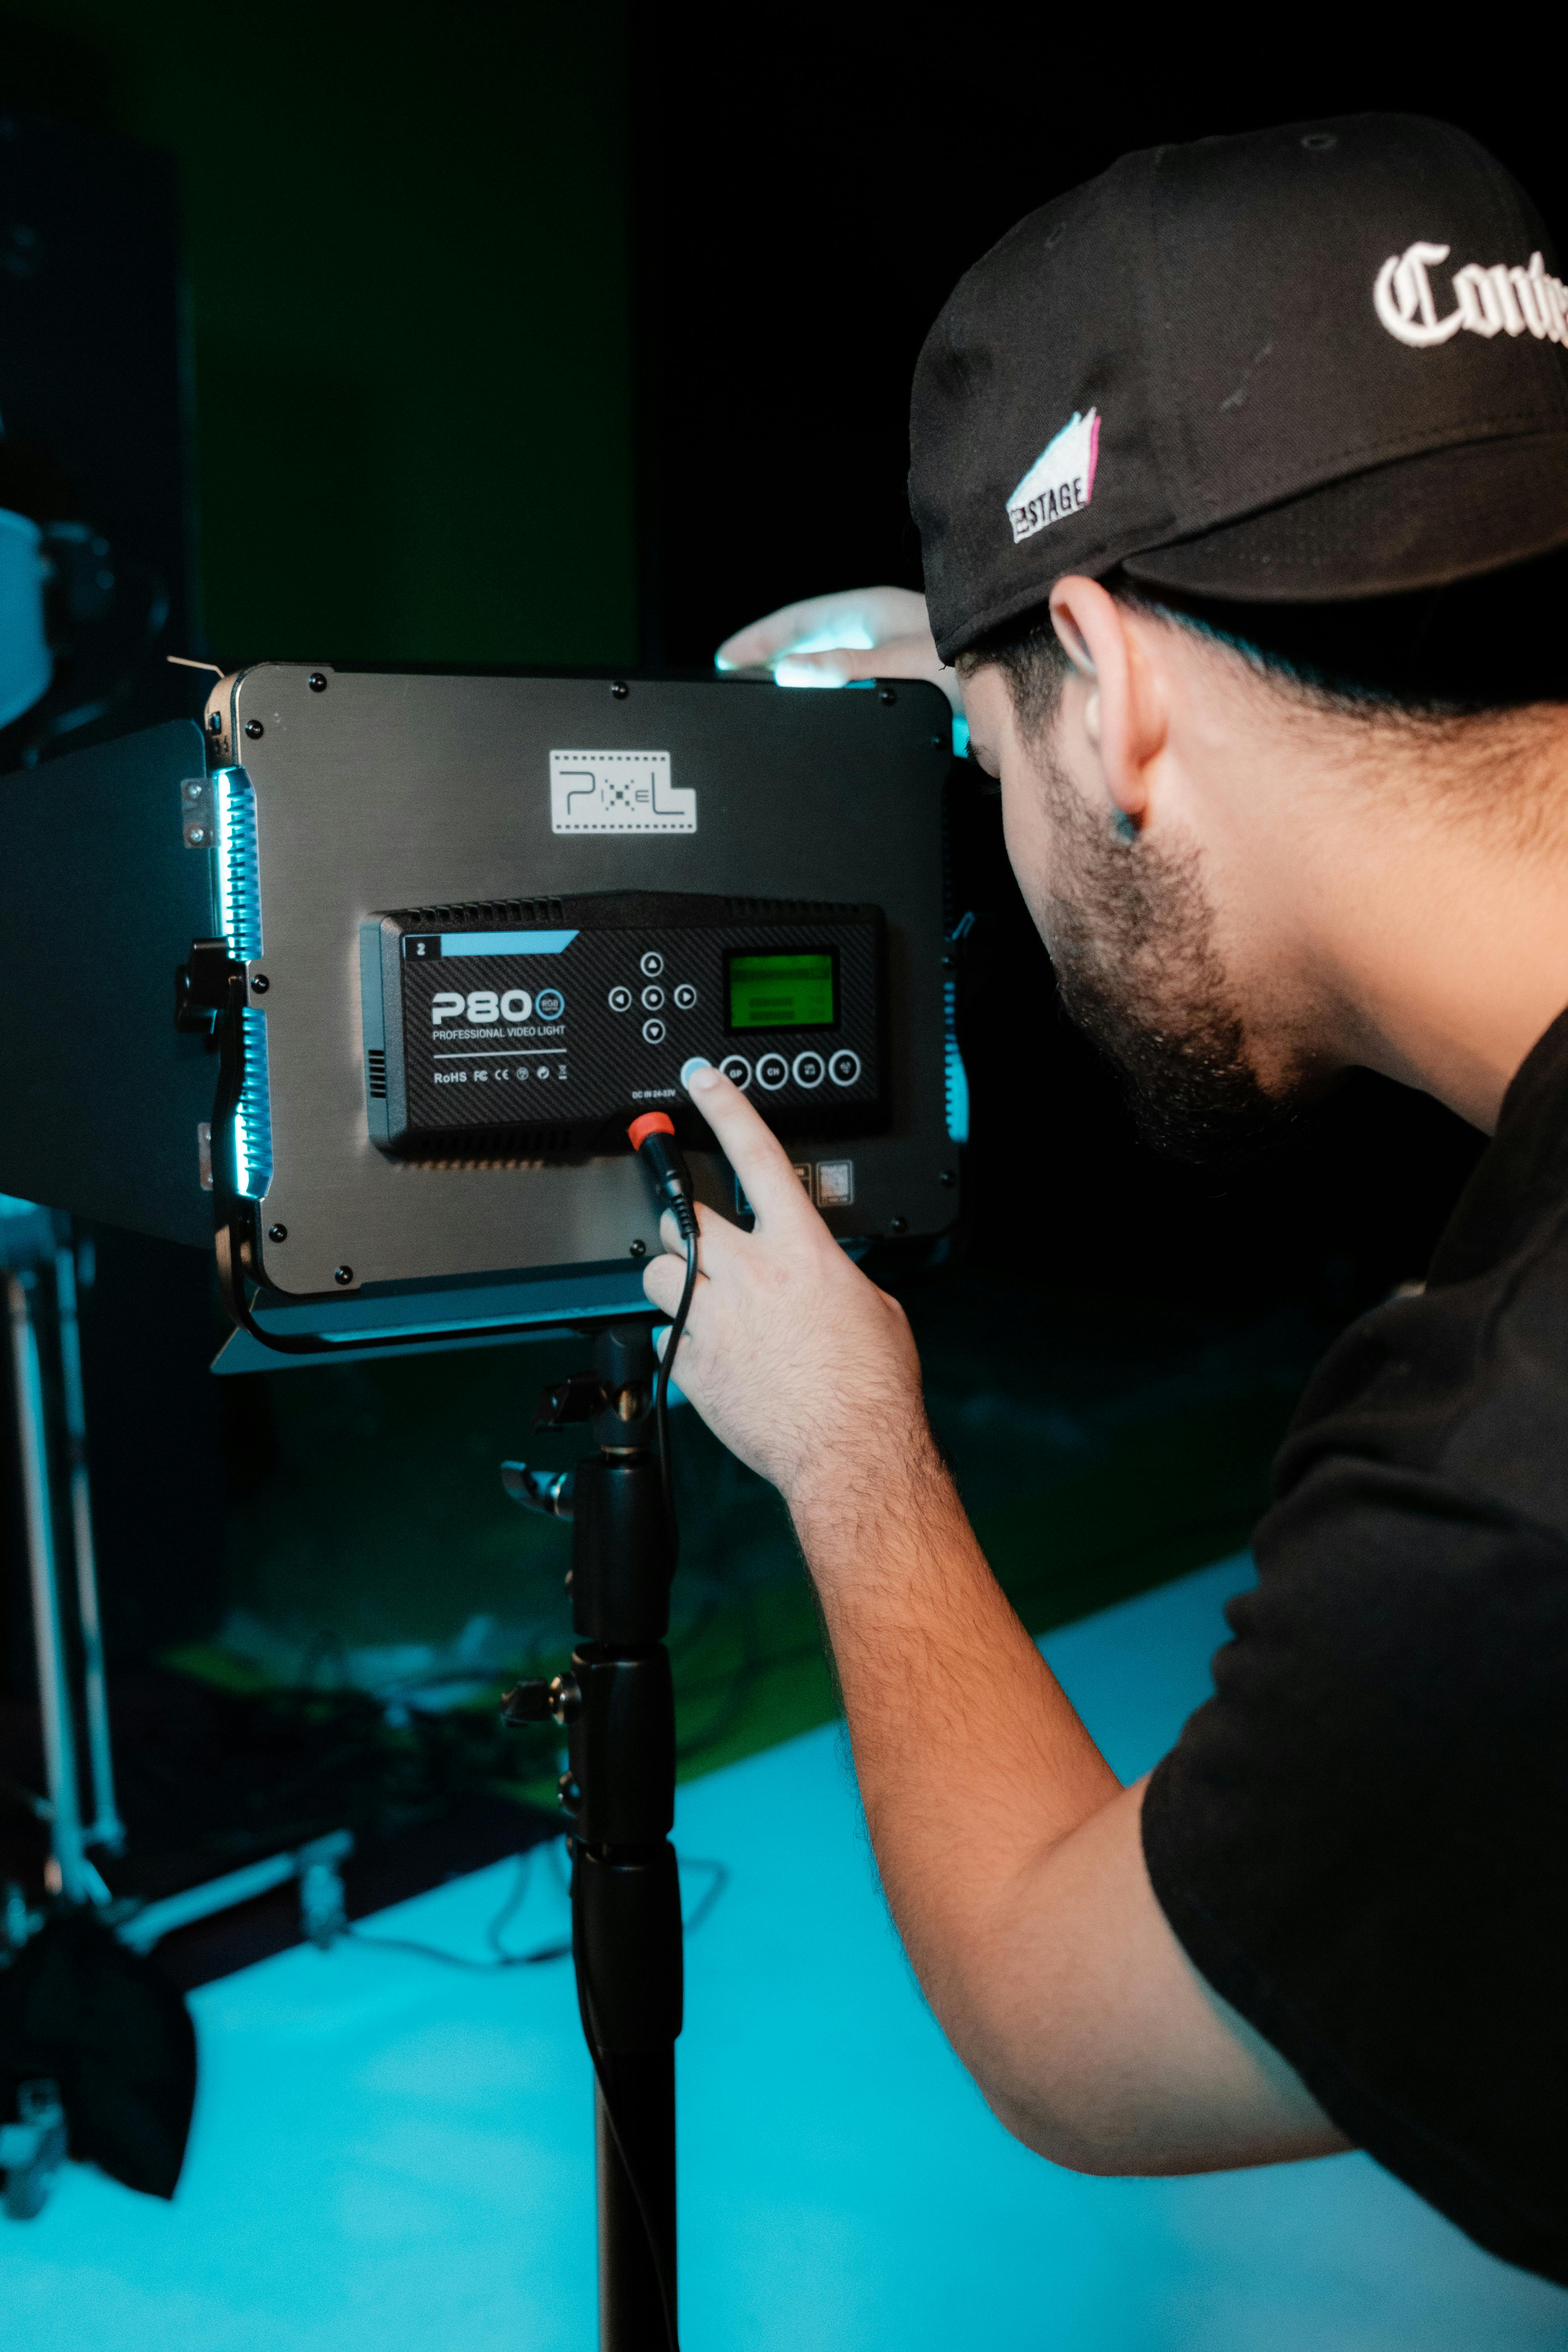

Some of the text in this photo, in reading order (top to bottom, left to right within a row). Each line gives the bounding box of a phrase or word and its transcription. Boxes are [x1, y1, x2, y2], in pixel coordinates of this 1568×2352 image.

[432, 989, 533, 1025] P80
[433, 1025, 566, 1040] PROFESSIONAL VIDEO LIGHT
[434, 1071, 467, 1083] RoHS
